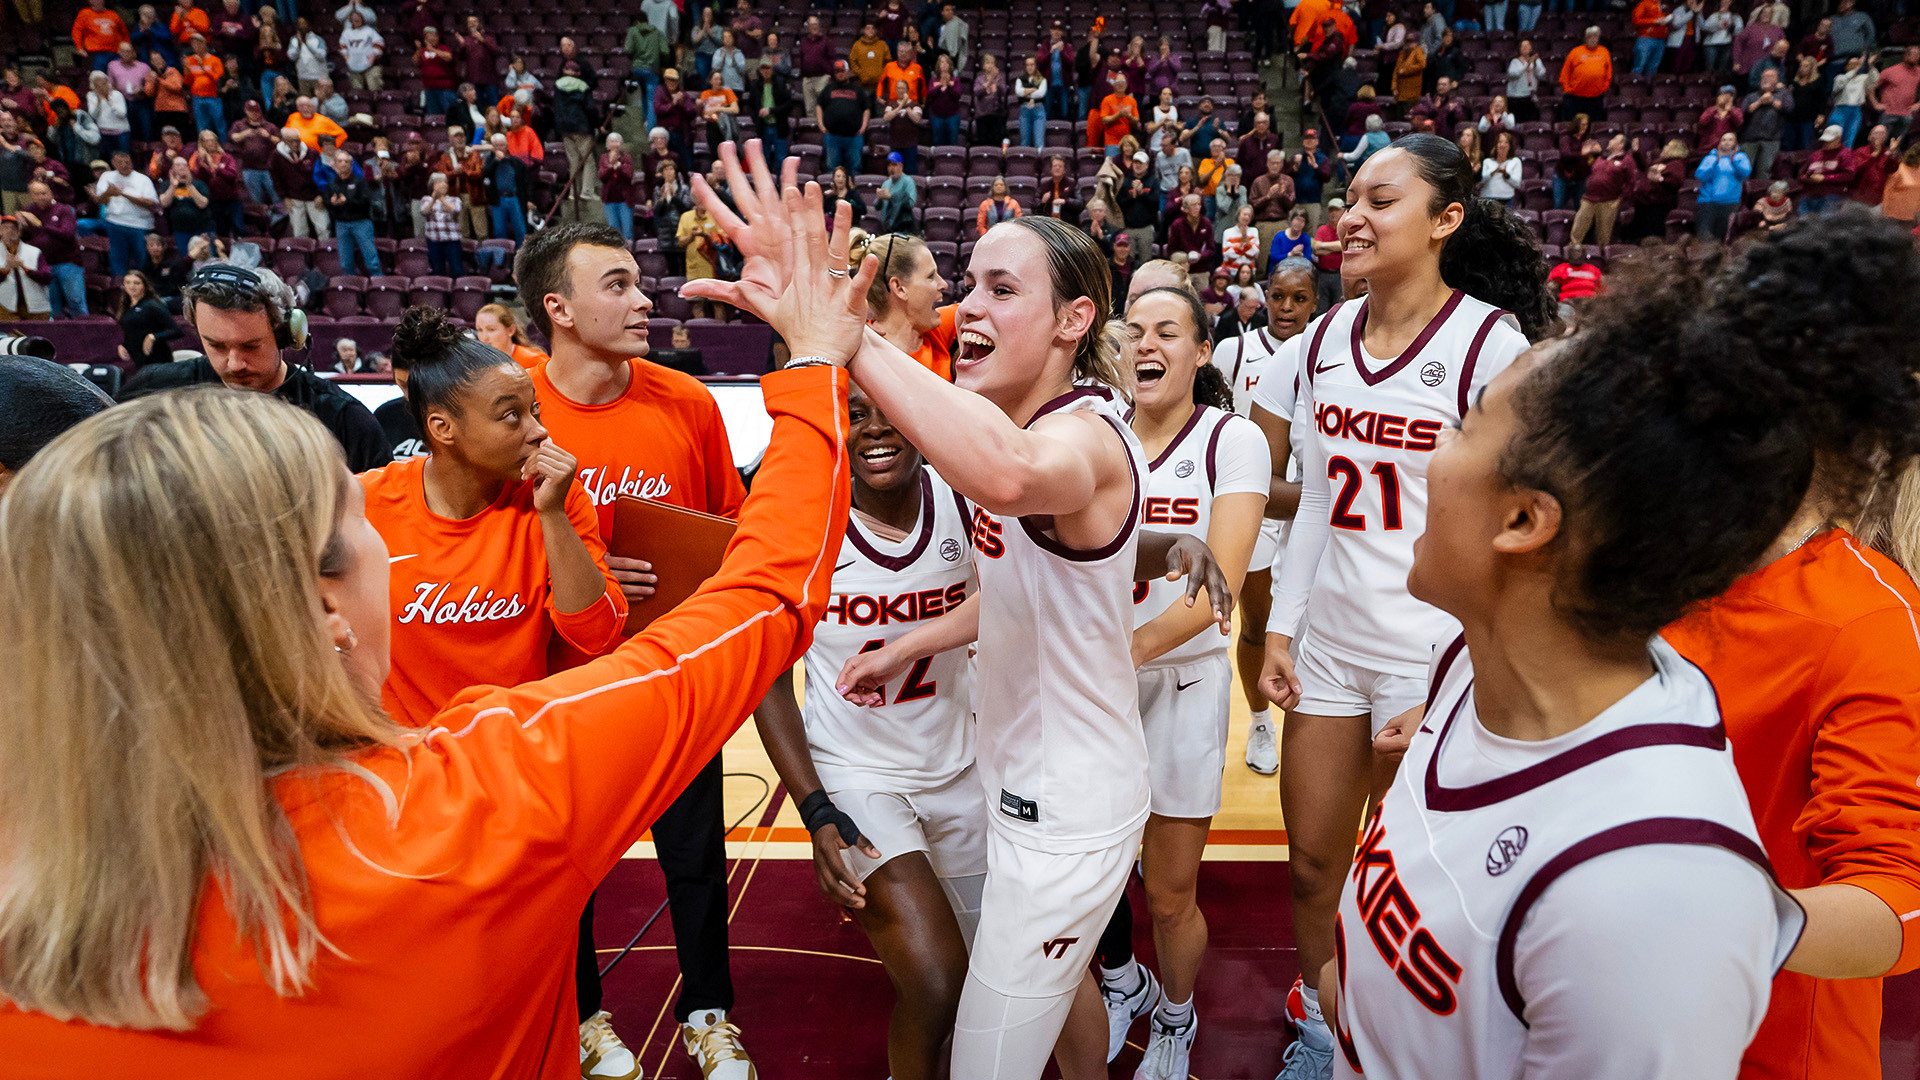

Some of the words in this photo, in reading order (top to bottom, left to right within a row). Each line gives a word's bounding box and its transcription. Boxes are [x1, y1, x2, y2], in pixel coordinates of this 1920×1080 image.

[392, 438, 432, 457] AC
[1314, 401, 1443, 452] HOKIES
[580, 465, 672, 507] Hokies
[1327, 455, 1403, 531] 21
[398, 582, 526, 625] Hokies
[820, 580, 968, 627] HOKIES
[1022, 806, 1032, 816] M
[1042, 936, 1081, 960] VT
